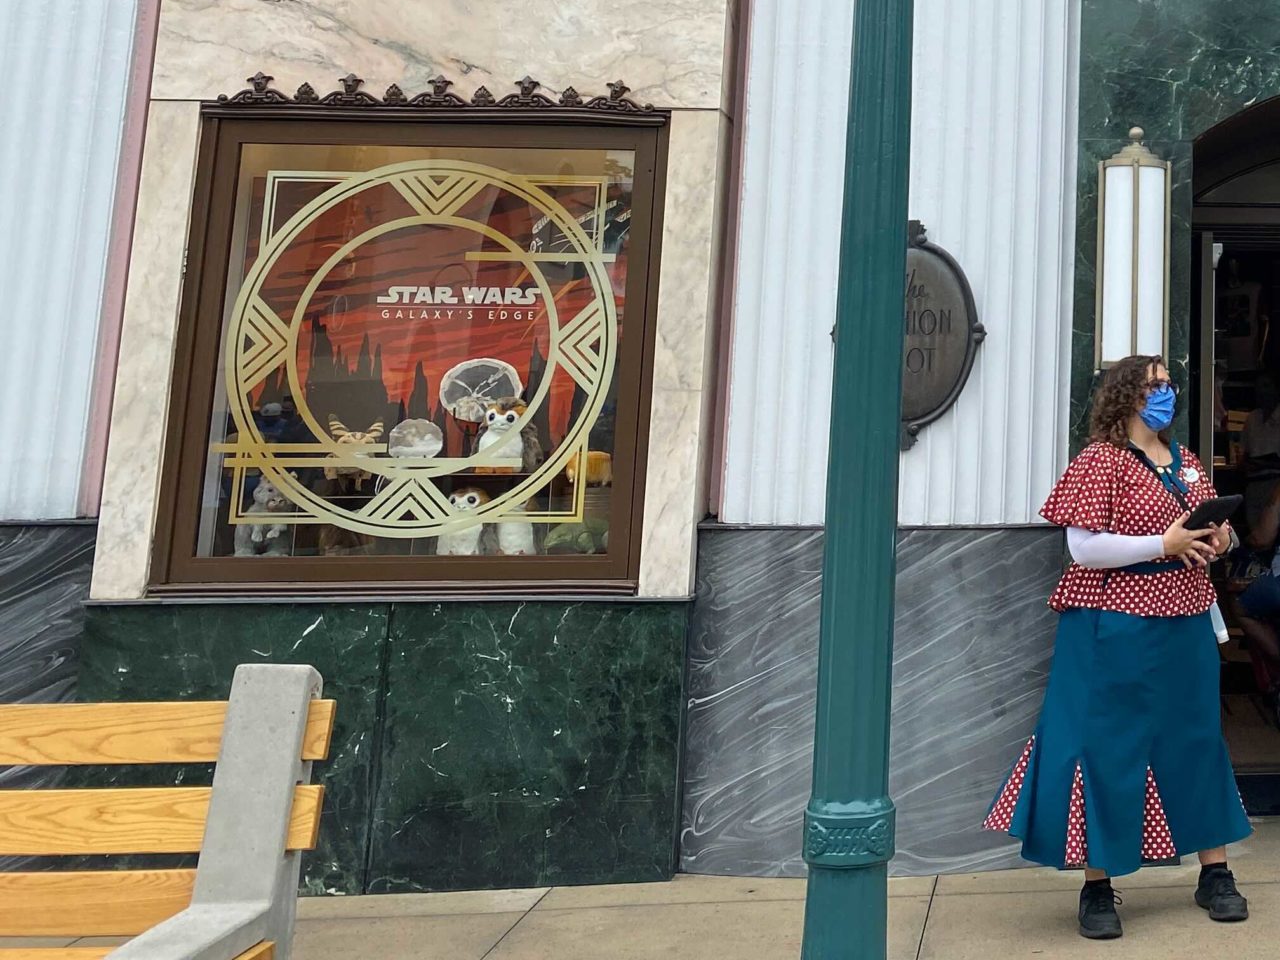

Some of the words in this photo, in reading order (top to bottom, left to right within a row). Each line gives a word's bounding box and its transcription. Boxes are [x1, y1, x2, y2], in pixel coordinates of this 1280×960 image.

[376, 285, 459, 304] STAR
[461, 286, 542, 305] WARS
[381, 309, 473, 320] GALAXY'S
[488, 310, 534, 320] EDGE
